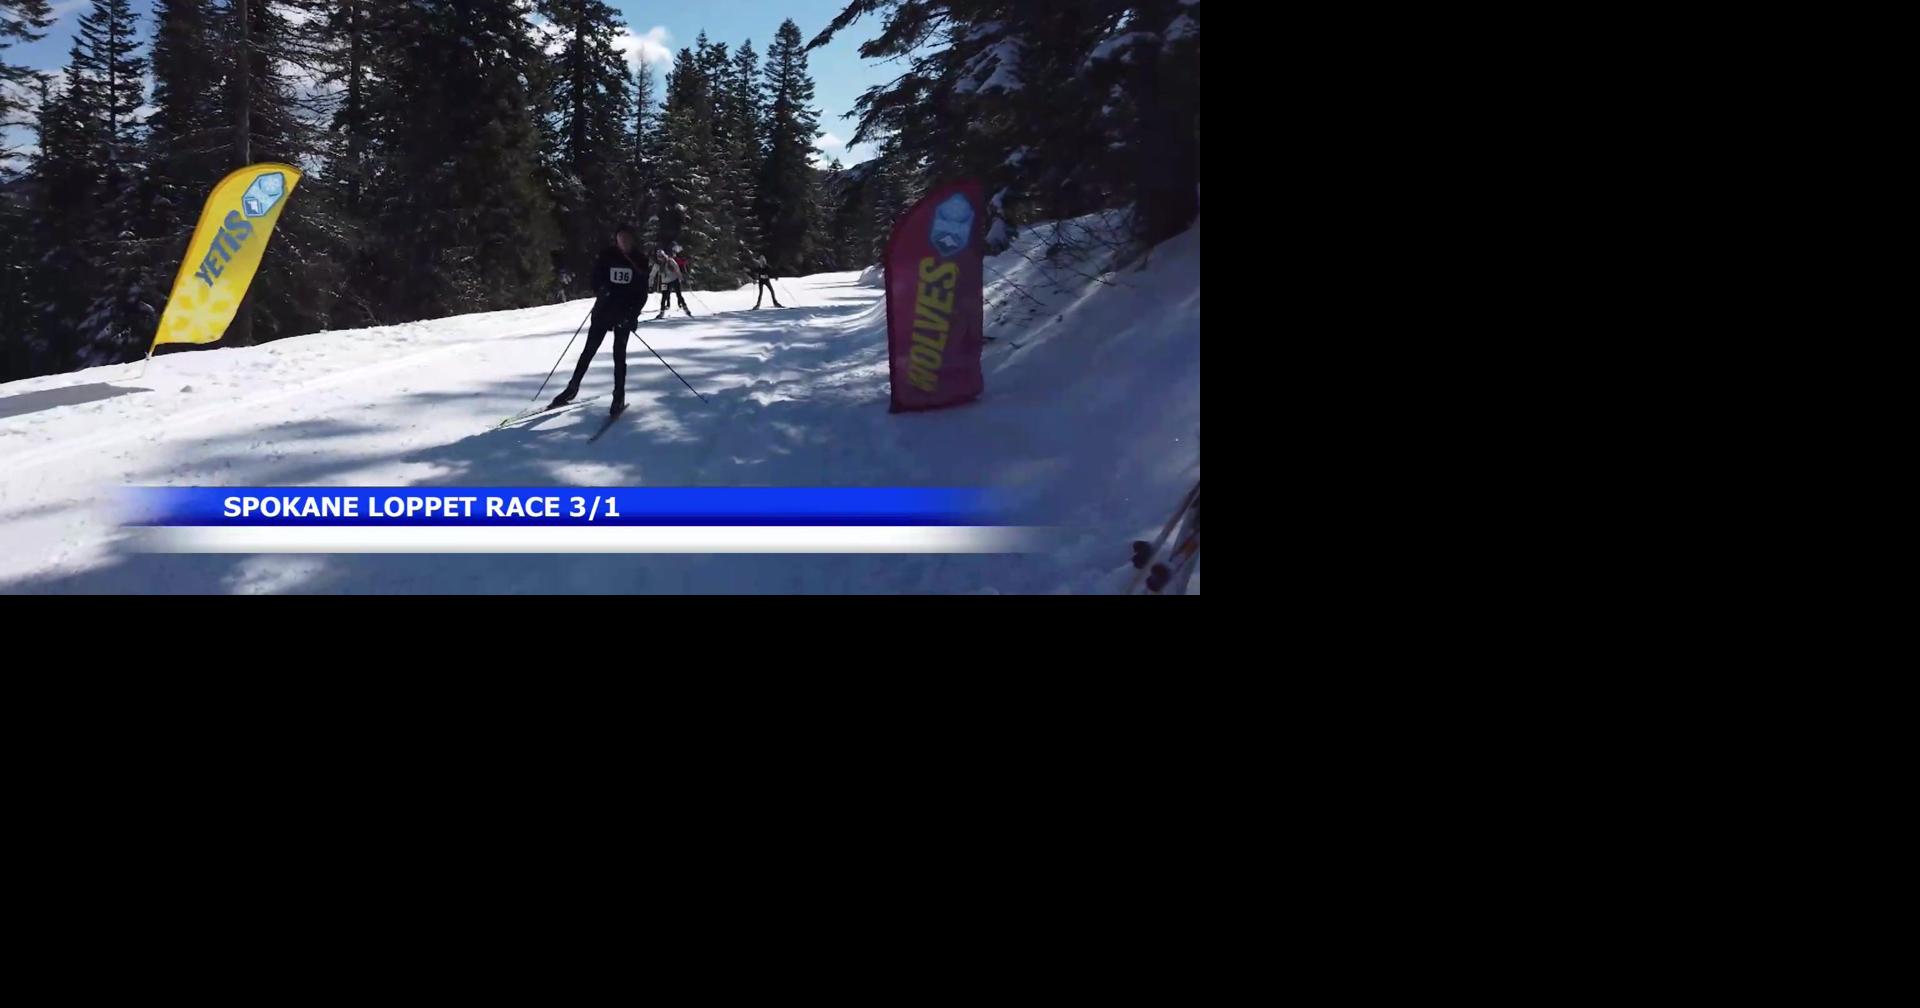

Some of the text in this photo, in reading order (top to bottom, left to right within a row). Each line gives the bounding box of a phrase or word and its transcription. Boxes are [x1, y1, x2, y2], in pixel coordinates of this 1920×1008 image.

[194, 209, 254, 288] YETIS
[613, 271, 630, 282] 136
[907, 256, 960, 392] WOLVES
